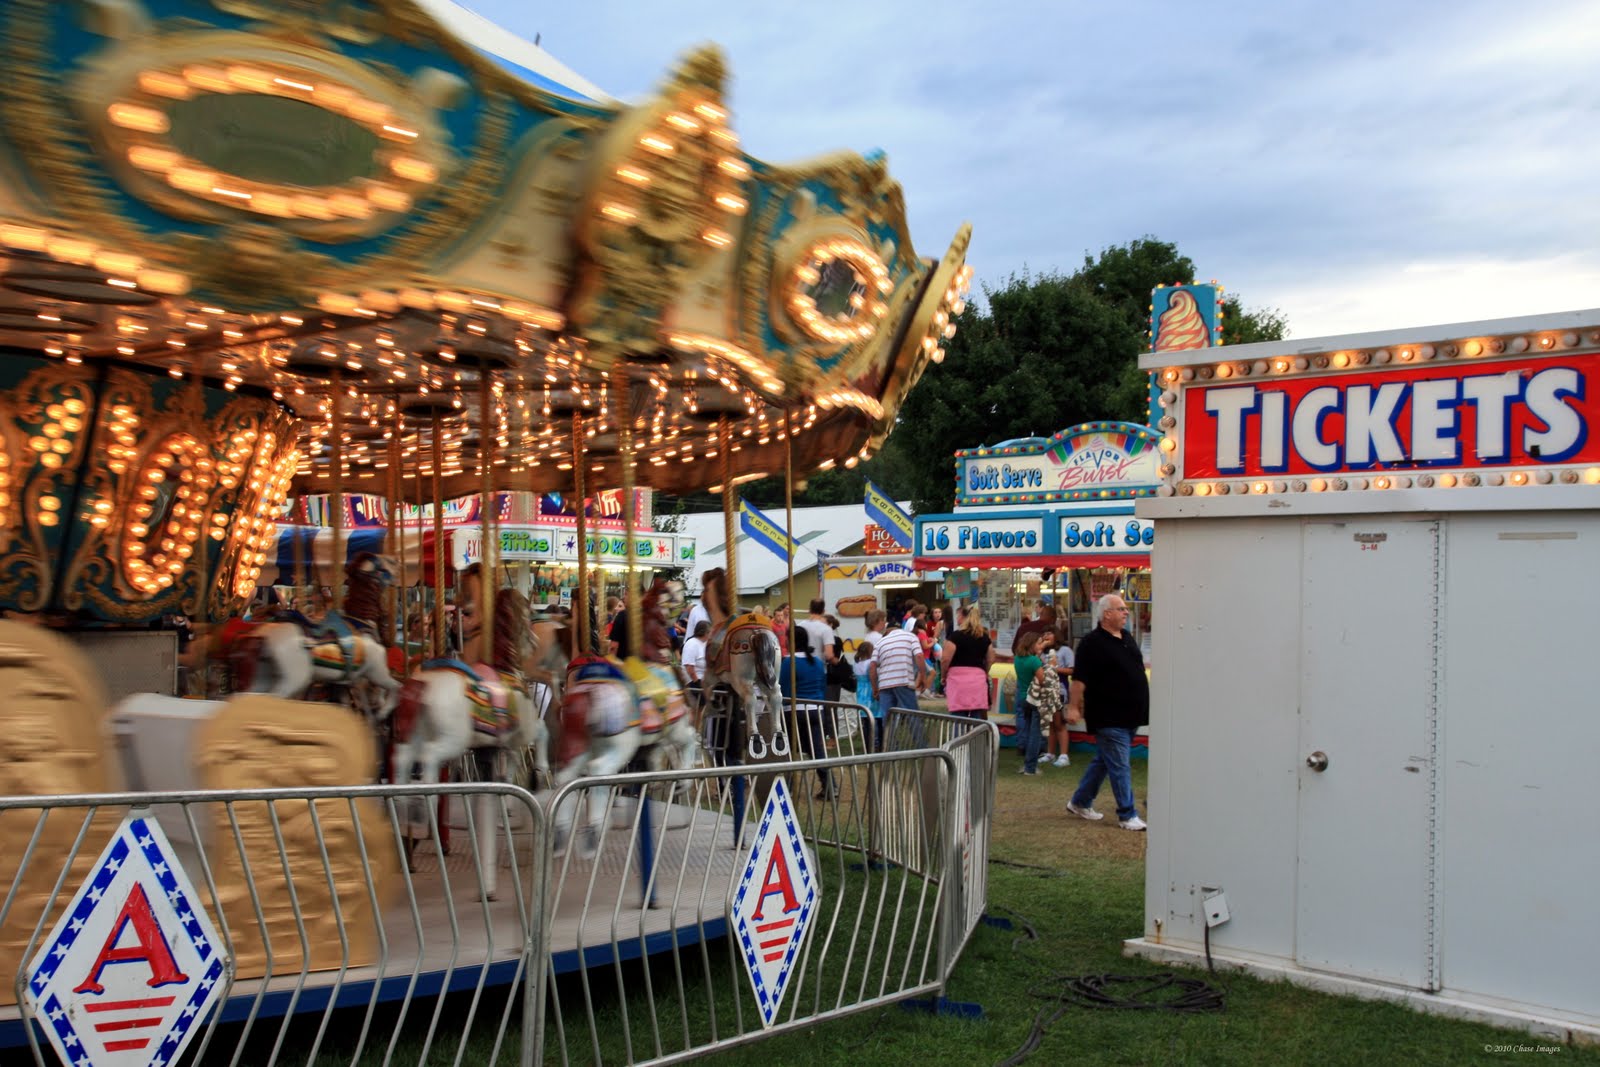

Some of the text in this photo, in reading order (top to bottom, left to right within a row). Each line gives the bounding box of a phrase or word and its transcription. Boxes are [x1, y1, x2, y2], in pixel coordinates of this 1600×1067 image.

[1205, 366, 1588, 474] TICKETS
[1073, 449, 1120, 470] FLAVOR
[969, 463, 1042, 490] Soft Serve
[1058, 457, 1142, 490] Burst
[497, 538, 549, 552] RINKS
[501, 531, 530, 540] COLD
[612, 537, 653, 556] KOES
[871, 529, 893, 541] HO
[924, 525, 1037, 551] 16 Flavors
[1064, 521, 1115, 547] Soft
[866, 563, 914, 580] SABRETT
[751, 833, 801, 922] A
[72, 880, 190, 996] A
